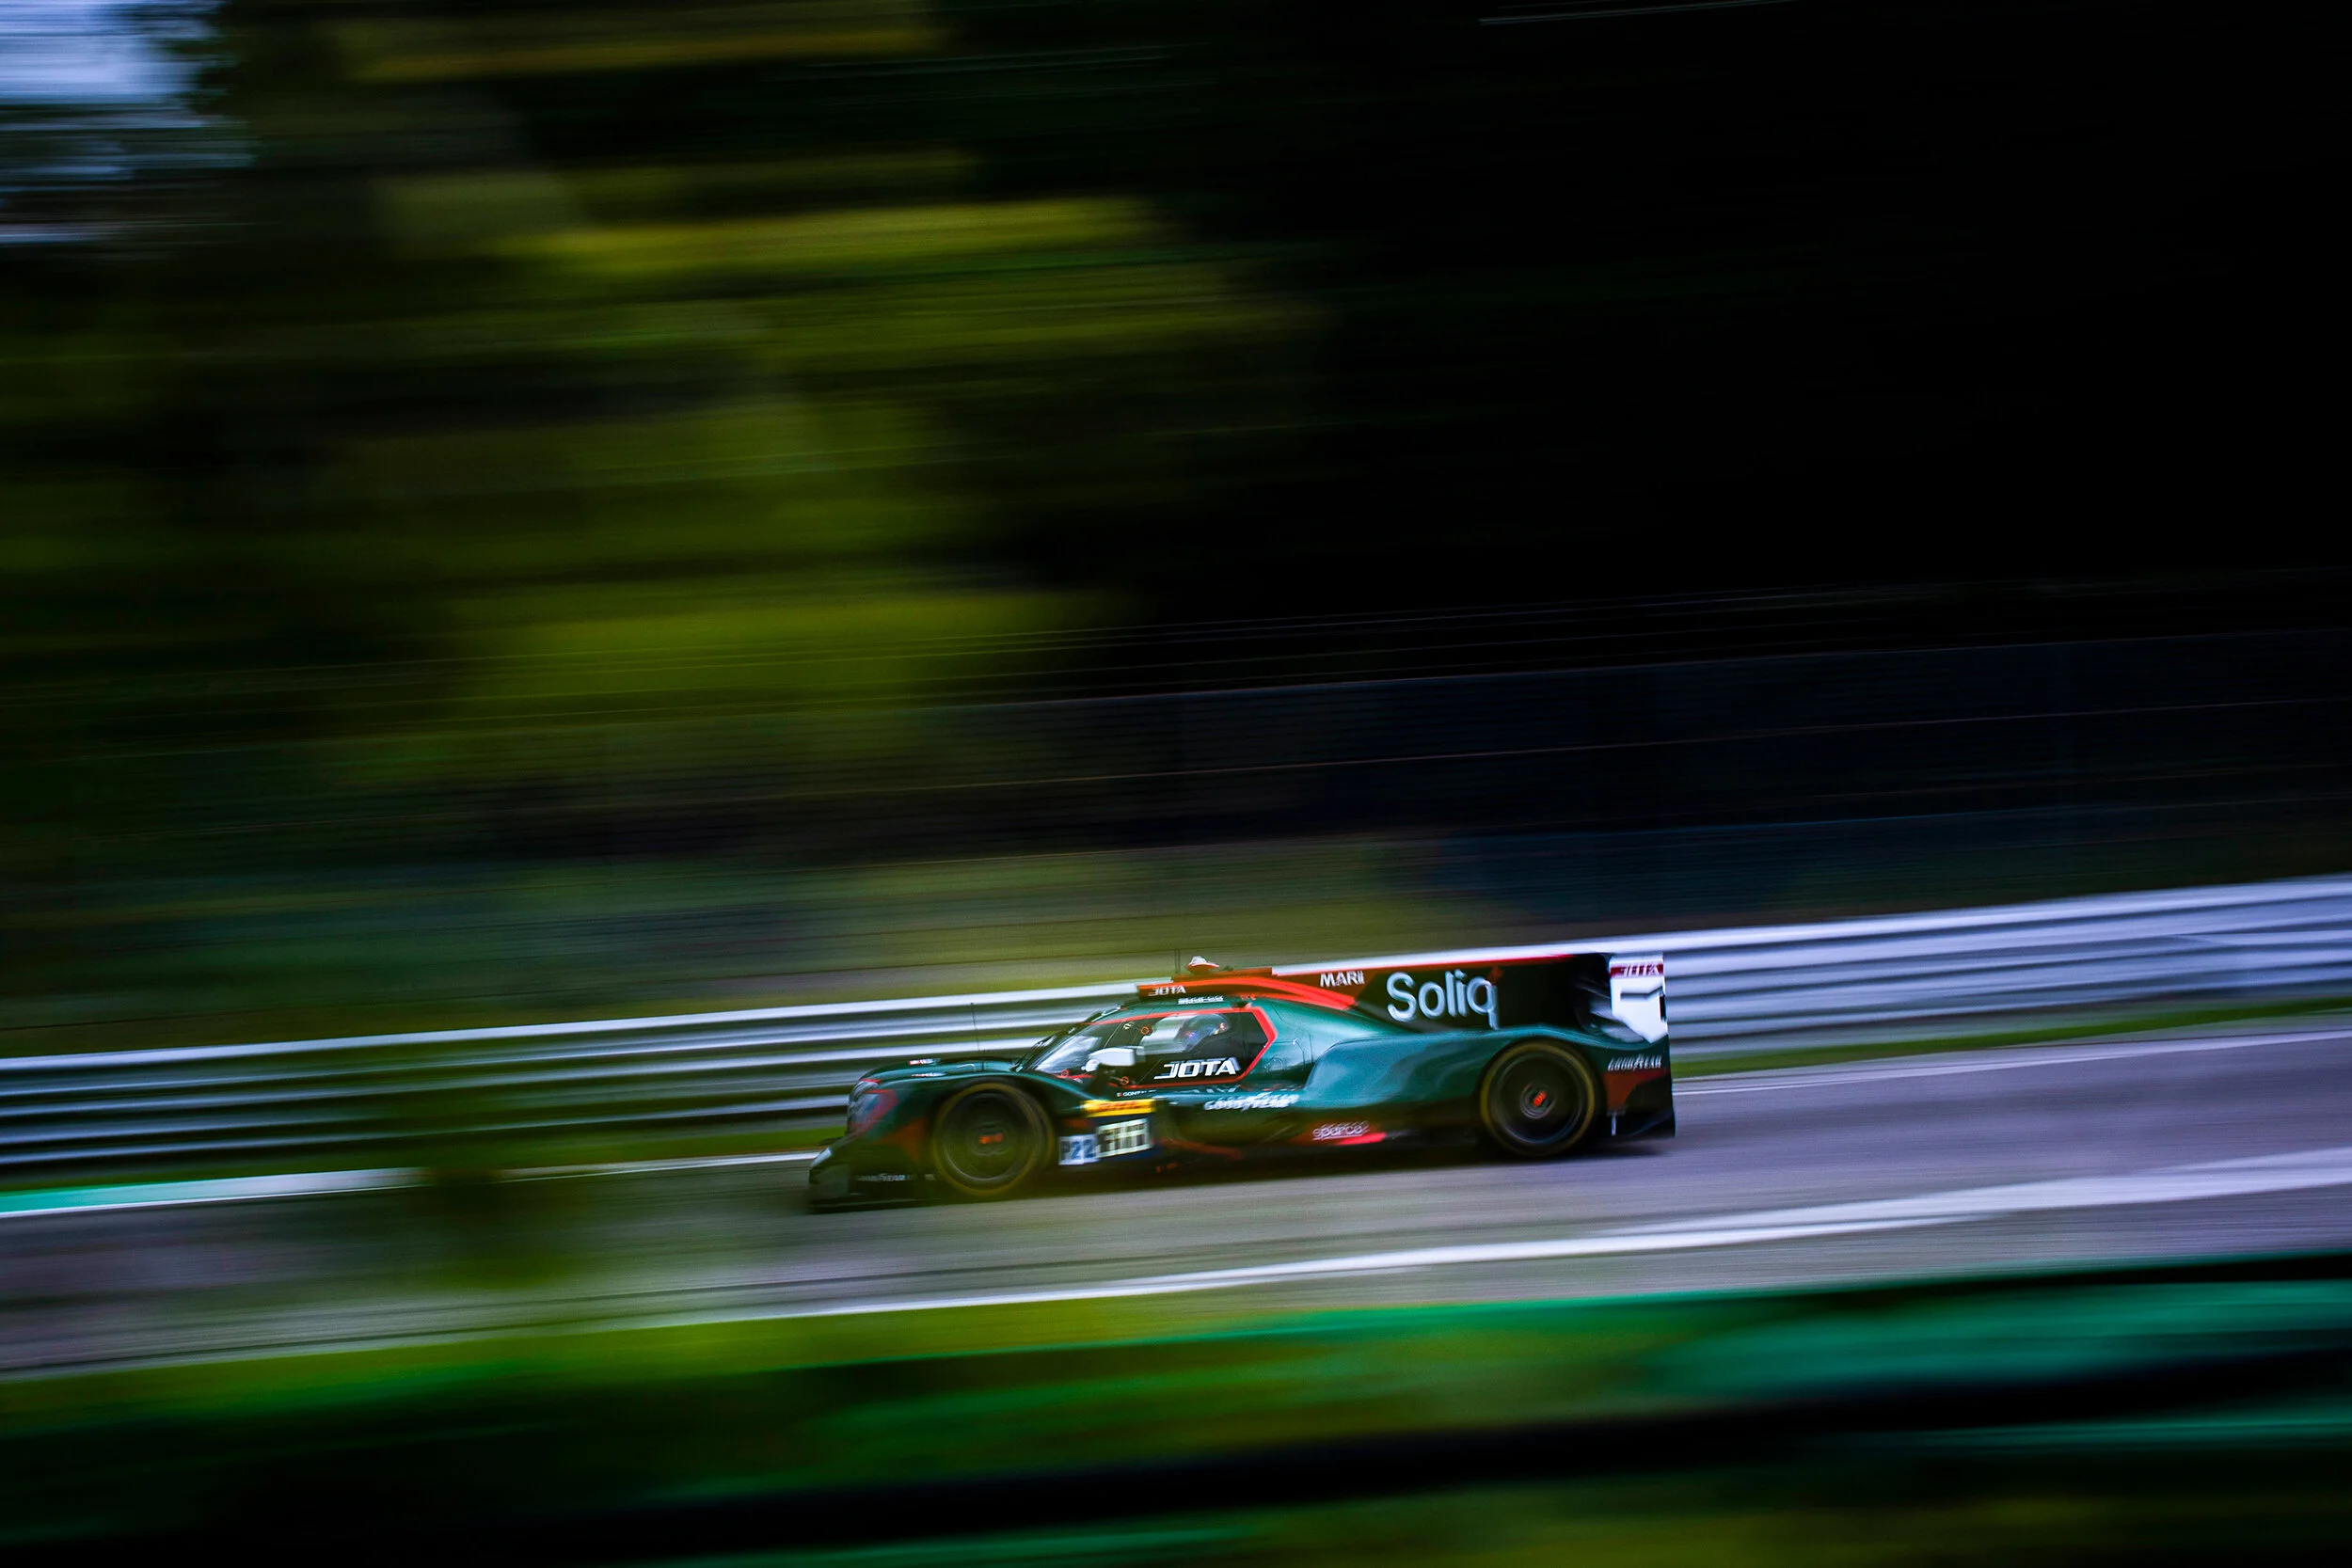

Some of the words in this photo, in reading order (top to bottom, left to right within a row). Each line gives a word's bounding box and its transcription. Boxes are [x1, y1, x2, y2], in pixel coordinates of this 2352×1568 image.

[1148, 984, 1187, 997] JOTA
[1386, 968, 1499, 1031] Soliq
[1153, 1056, 1242, 1080] JOTA
